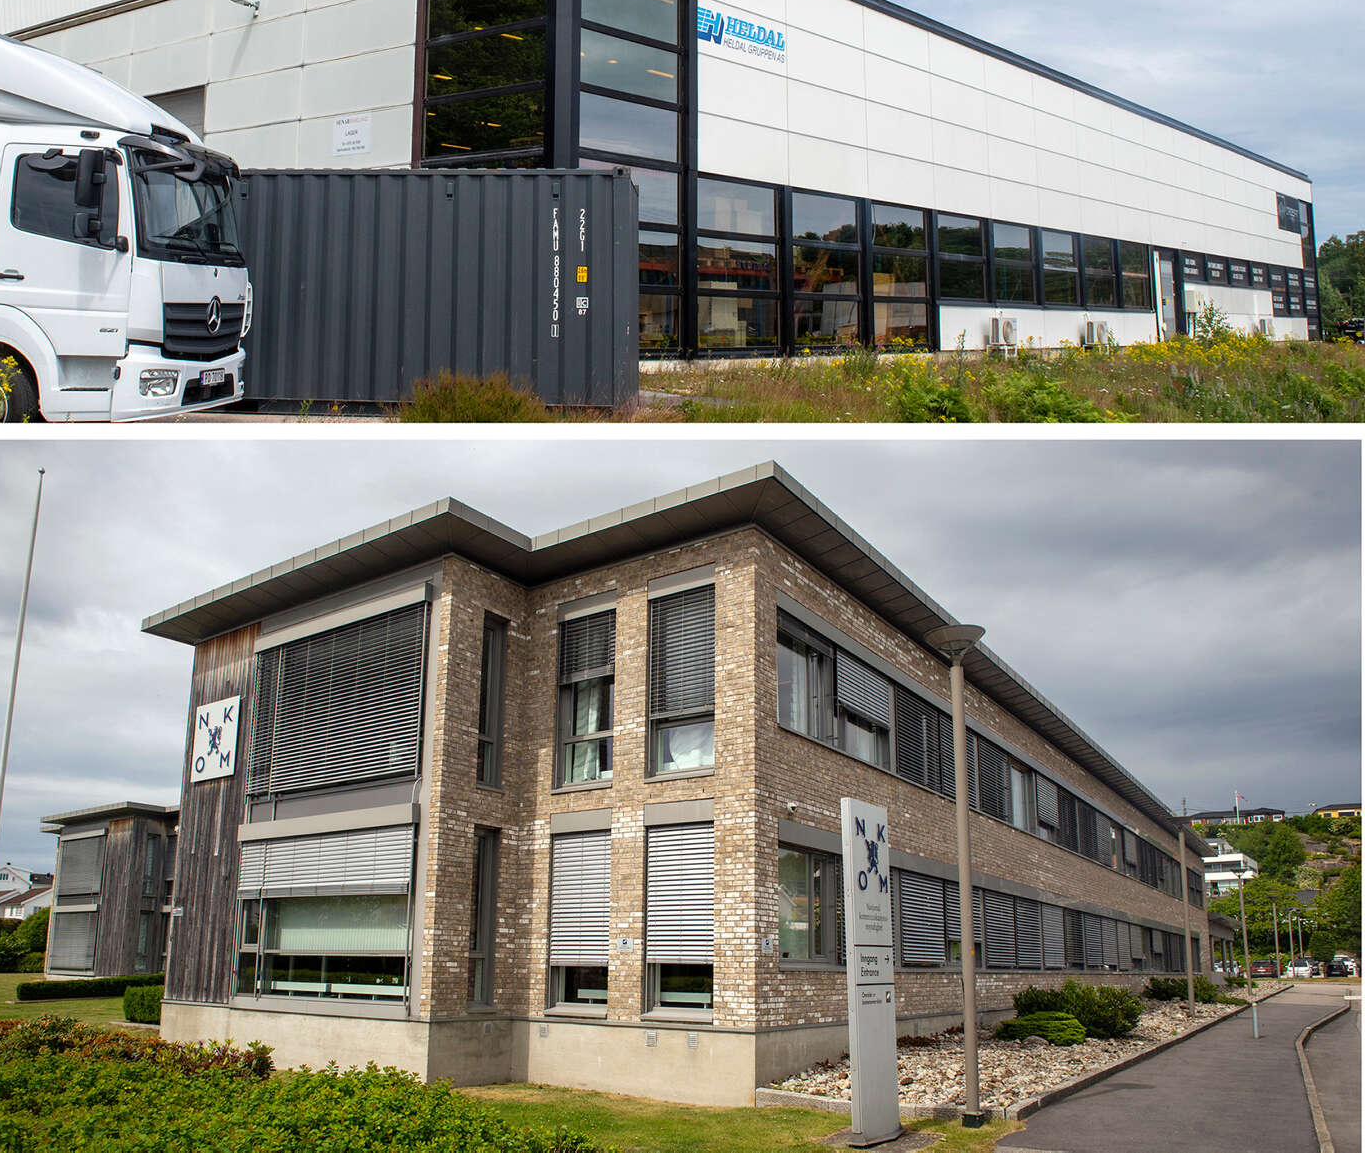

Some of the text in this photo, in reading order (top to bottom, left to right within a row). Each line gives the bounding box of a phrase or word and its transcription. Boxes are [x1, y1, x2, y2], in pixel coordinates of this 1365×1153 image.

[725, 16, 785, 51] HELDAL
[723, 38, 747, 53] HELDAL
[748, 45, 776, 62] GRUPPEN
[861, 953, 878, 965] Inngang
[861, 967, 880, 977] Entrance
